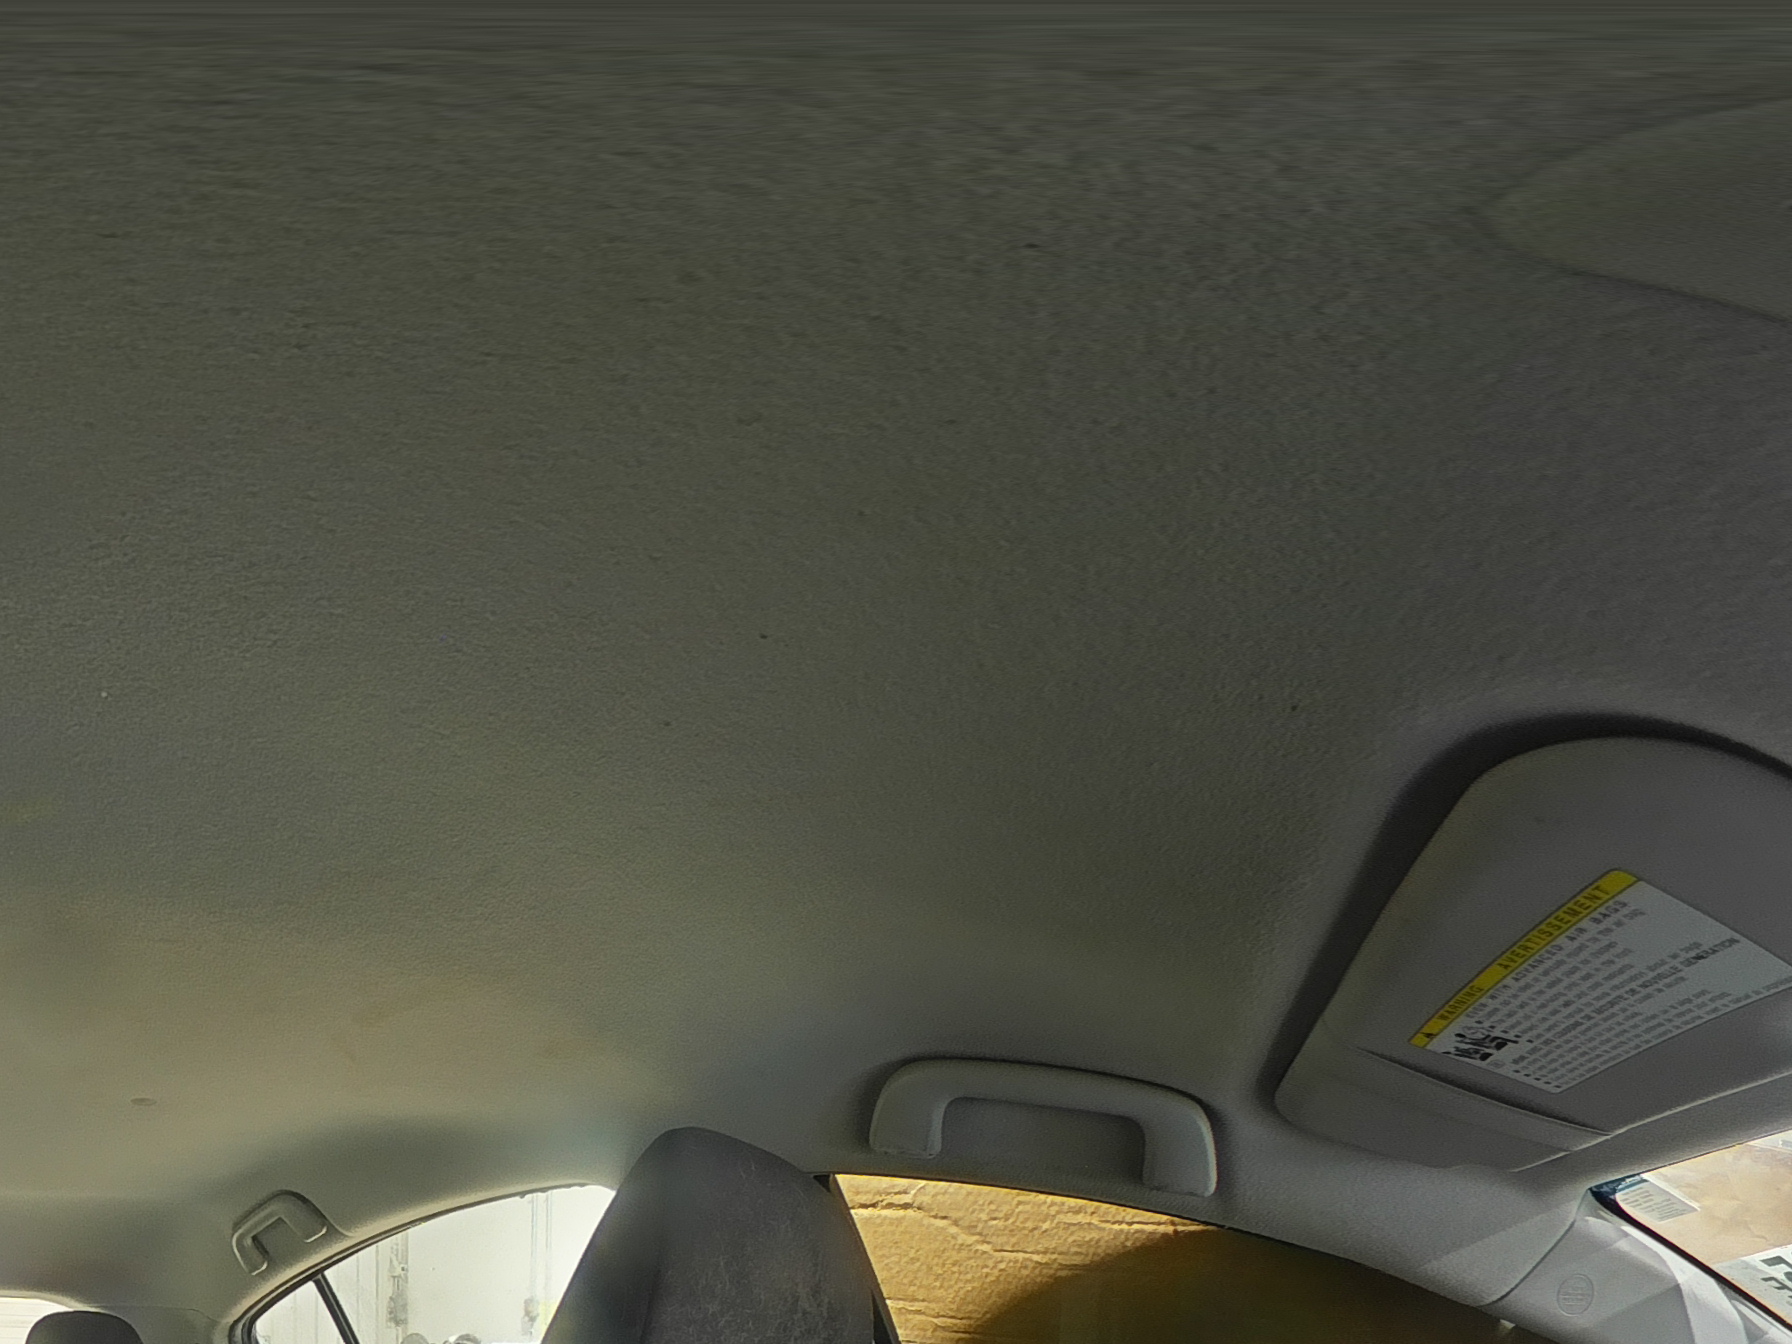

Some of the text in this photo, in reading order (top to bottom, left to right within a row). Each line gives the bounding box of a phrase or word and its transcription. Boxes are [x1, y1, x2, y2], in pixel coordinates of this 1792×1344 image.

[1589, 900, 1628, 924] BAGS
[1438, 885, 1611, 1021] WARNING AVERTISSEMENT
